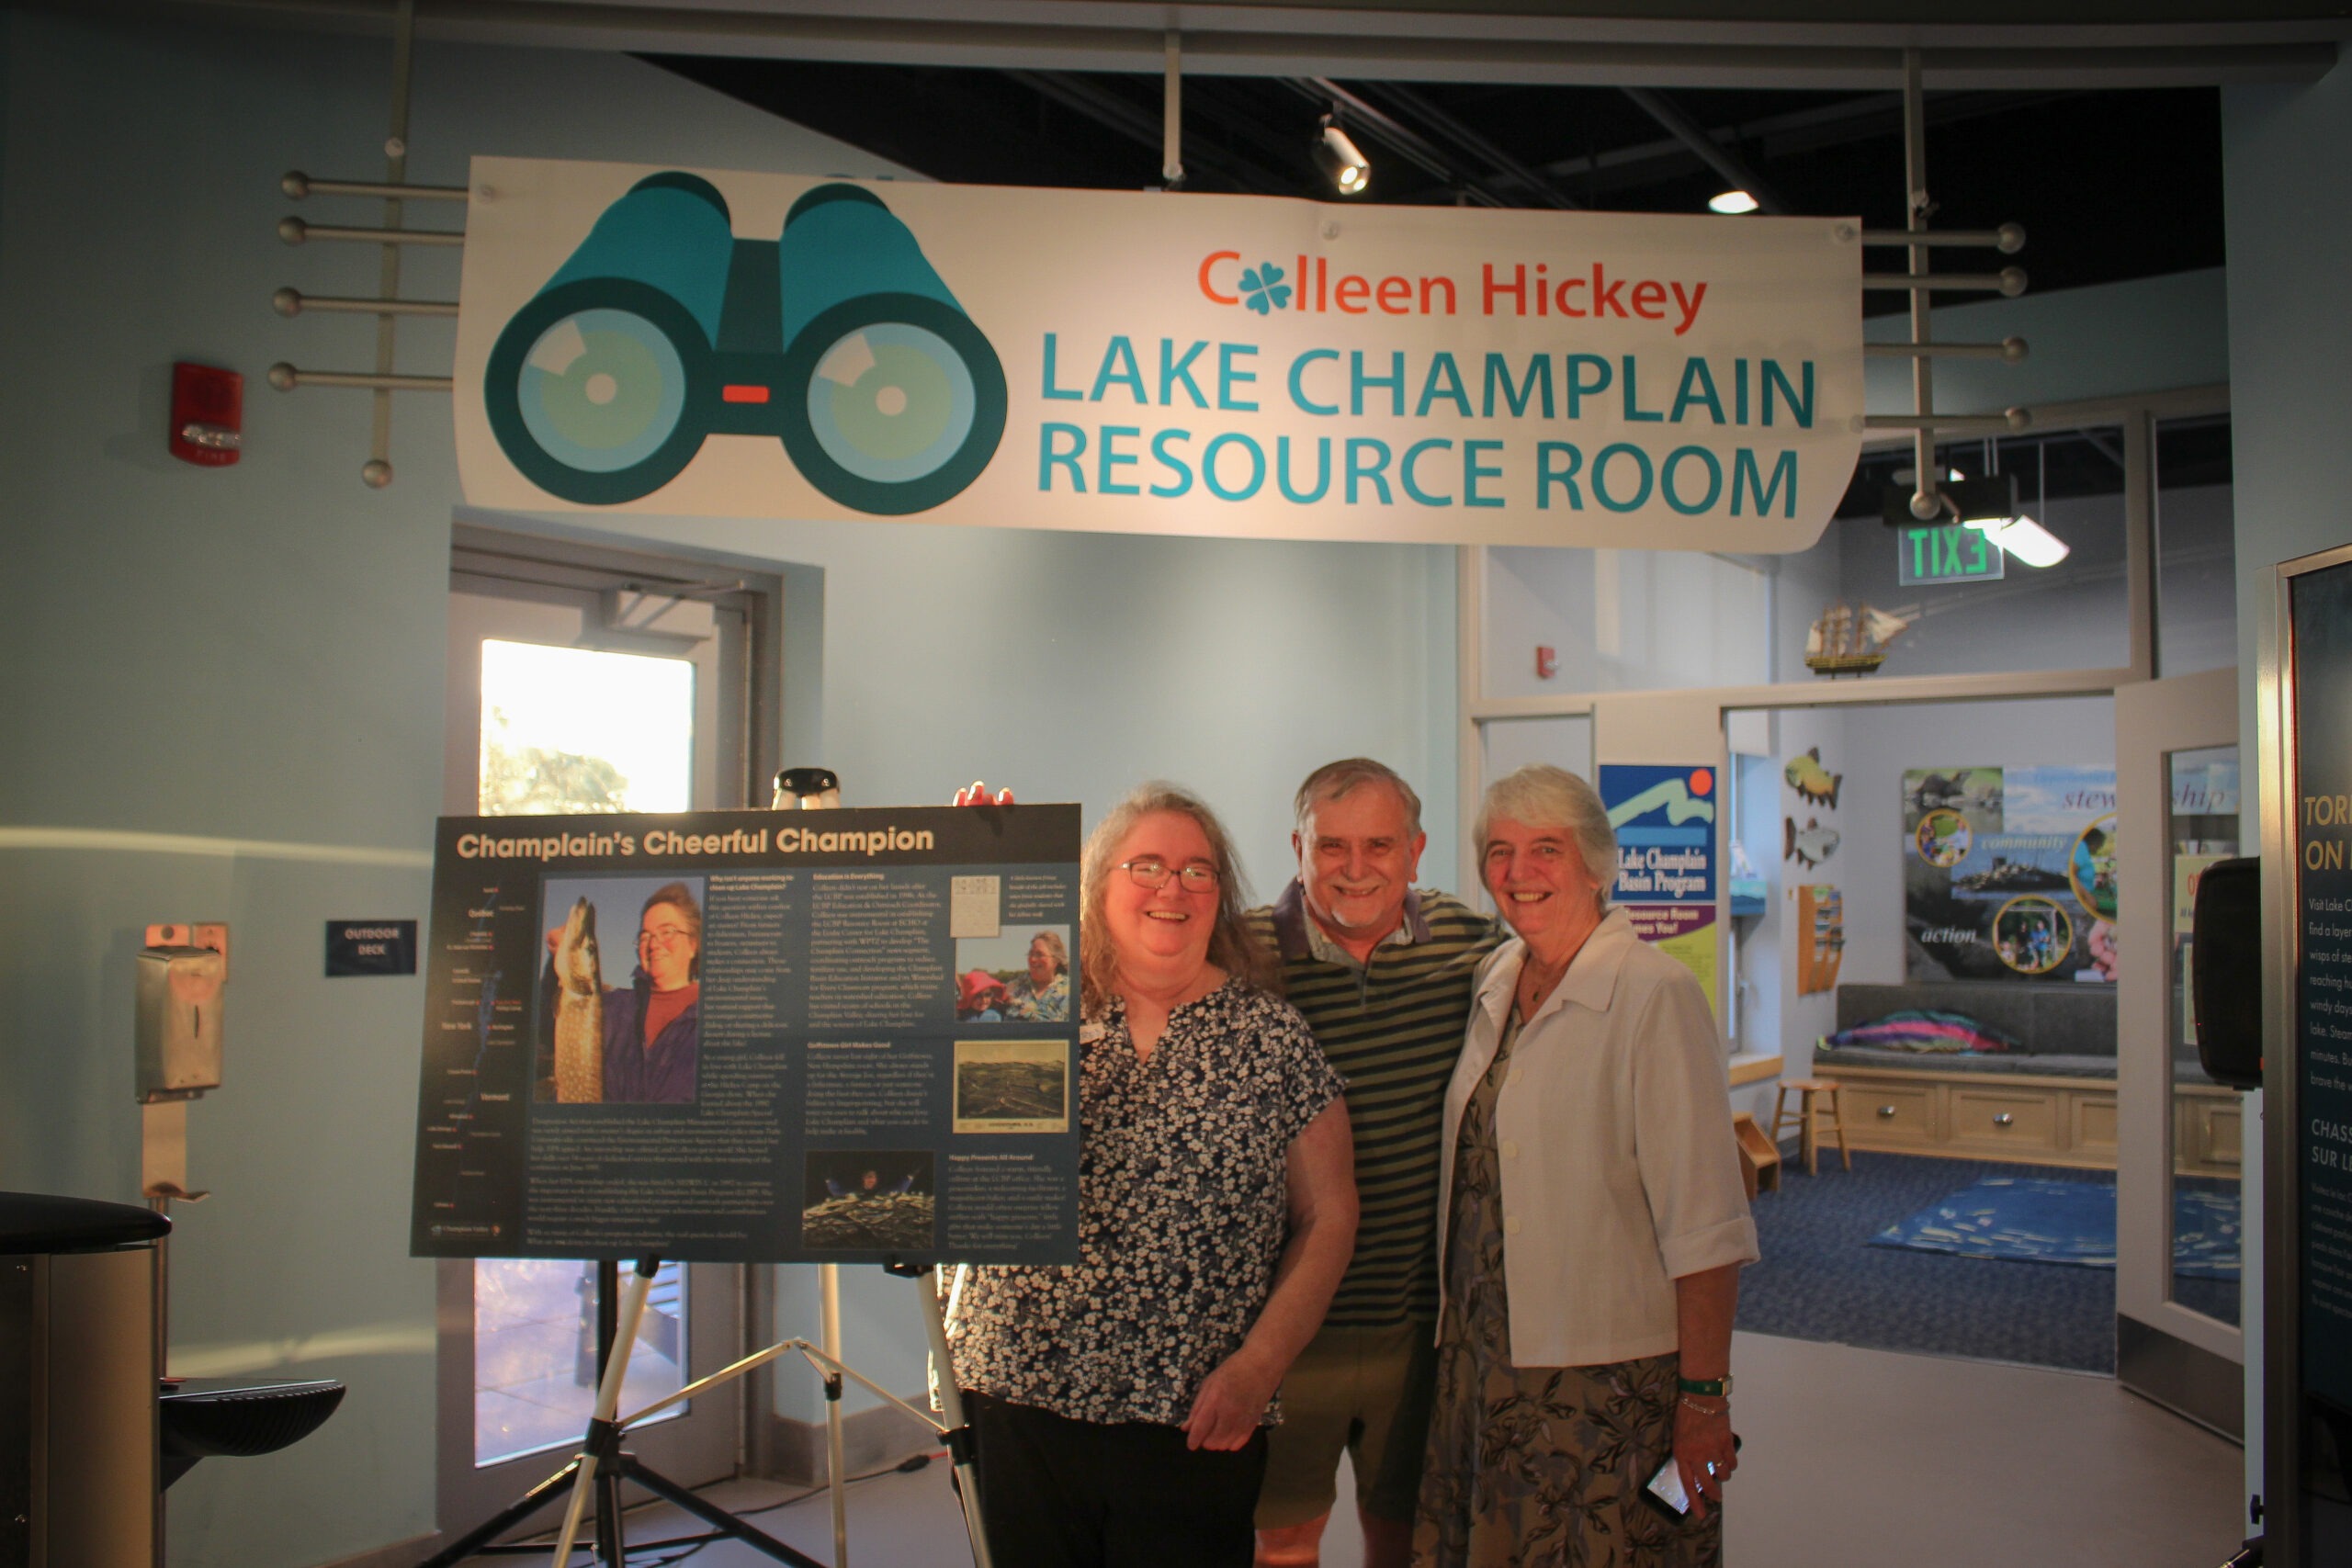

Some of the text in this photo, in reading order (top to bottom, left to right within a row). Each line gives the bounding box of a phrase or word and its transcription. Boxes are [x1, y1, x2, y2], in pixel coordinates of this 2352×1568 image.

[1482, 264, 1706, 336] Hickey
[1042, 332, 1815, 429] LAKE CHAMPLAIN
[1039, 422, 1799, 519] RESOURCE ROOM
[457, 825, 934, 863] Champlain's Cheerful Champion
[1981, 834, 2069, 852] community
[1617, 846, 1708, 876] Lake Champlain
[2305, 840, 2344, 871] ON
[1618, 870, 1707, 898] Basin Program
[2308, 897, 2324, 910] Visit
[2325, 897, 2343, 911] Lake
[345, 928, 399, 941] OUTDOOR
[1920, 924, 1977, 943] action
[2309, 921, 2324, 936] find
[2324, 928, 2331, 937] a
[357, 944, 385, 955] DECK
[2331, 948, 2340, 963] of
[2309, 974, 2342, 992] reaching
[2309, 998, 2333, 1015] windy
[2310, 1070, 2332, 1088] brave
[2334, 1076, 2346, 1090] the
[2311, 1145, 2338, 1168] SUR
